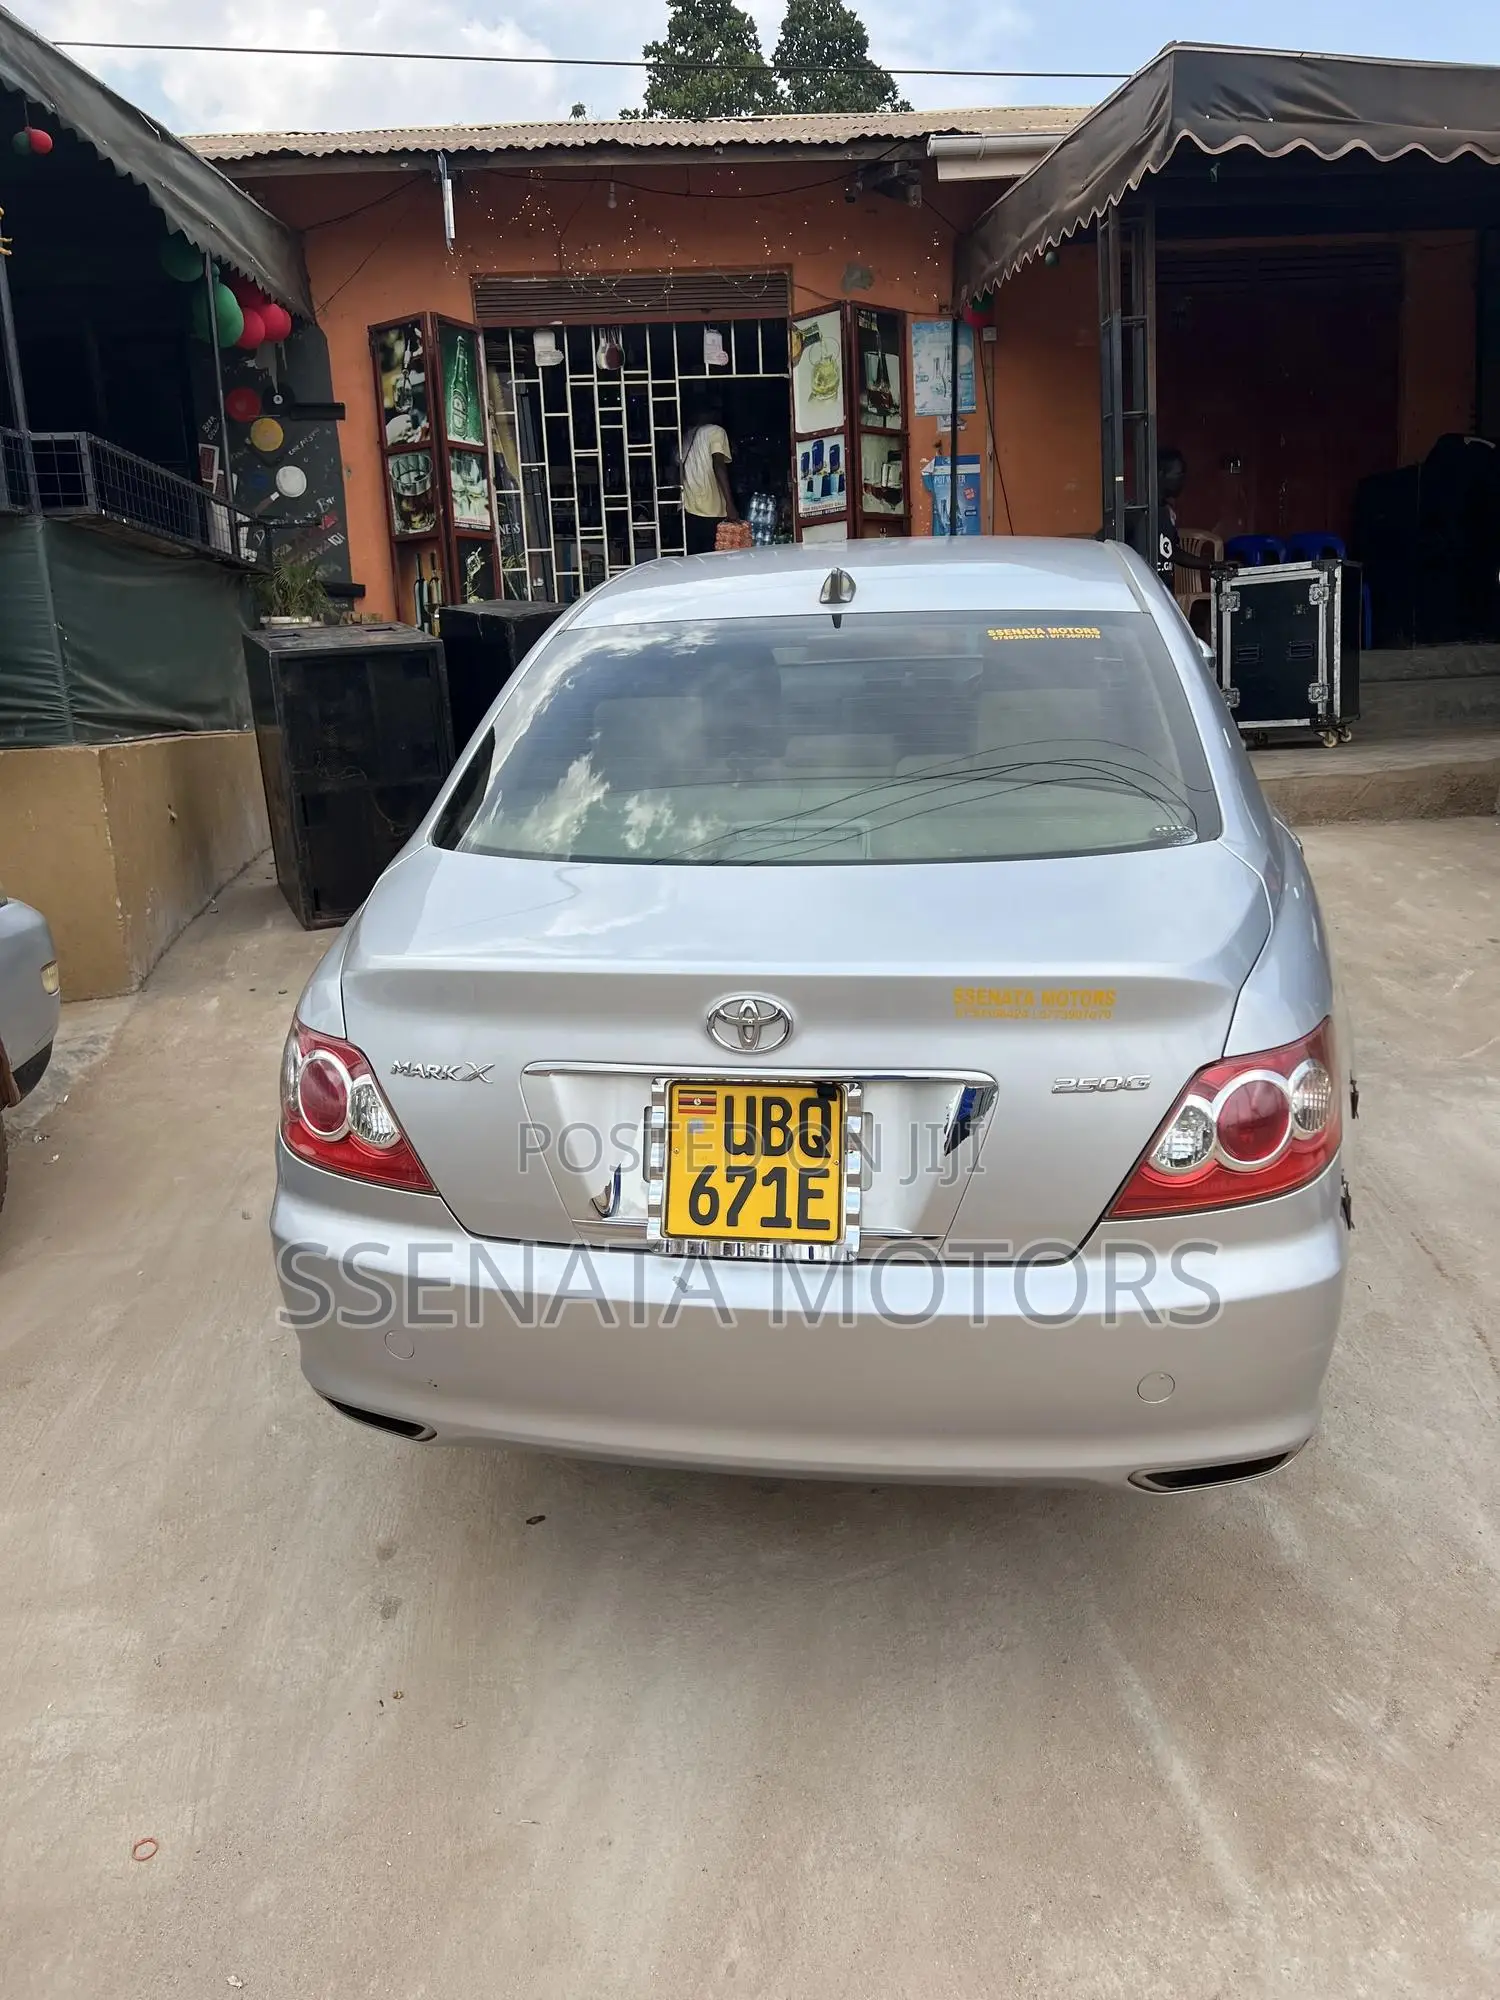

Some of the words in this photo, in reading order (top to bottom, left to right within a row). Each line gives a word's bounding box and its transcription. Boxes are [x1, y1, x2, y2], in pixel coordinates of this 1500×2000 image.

[987, 628, 1045, 636] SSENATA
[1046, 627, 1101, 636] MOTORS
[954, 987, 1035, 1006] SSENATA
[1041, 990, 1117, 1007] MOTORS
[390, 1060, 461, 1081] MARK
[461, 1061, 496, 1084] X
[1051, 1074, 1151, 1094] 250G
[723, 1094, 832, 1158] UBQ
[688, 1165, 831, 1230] 671E
